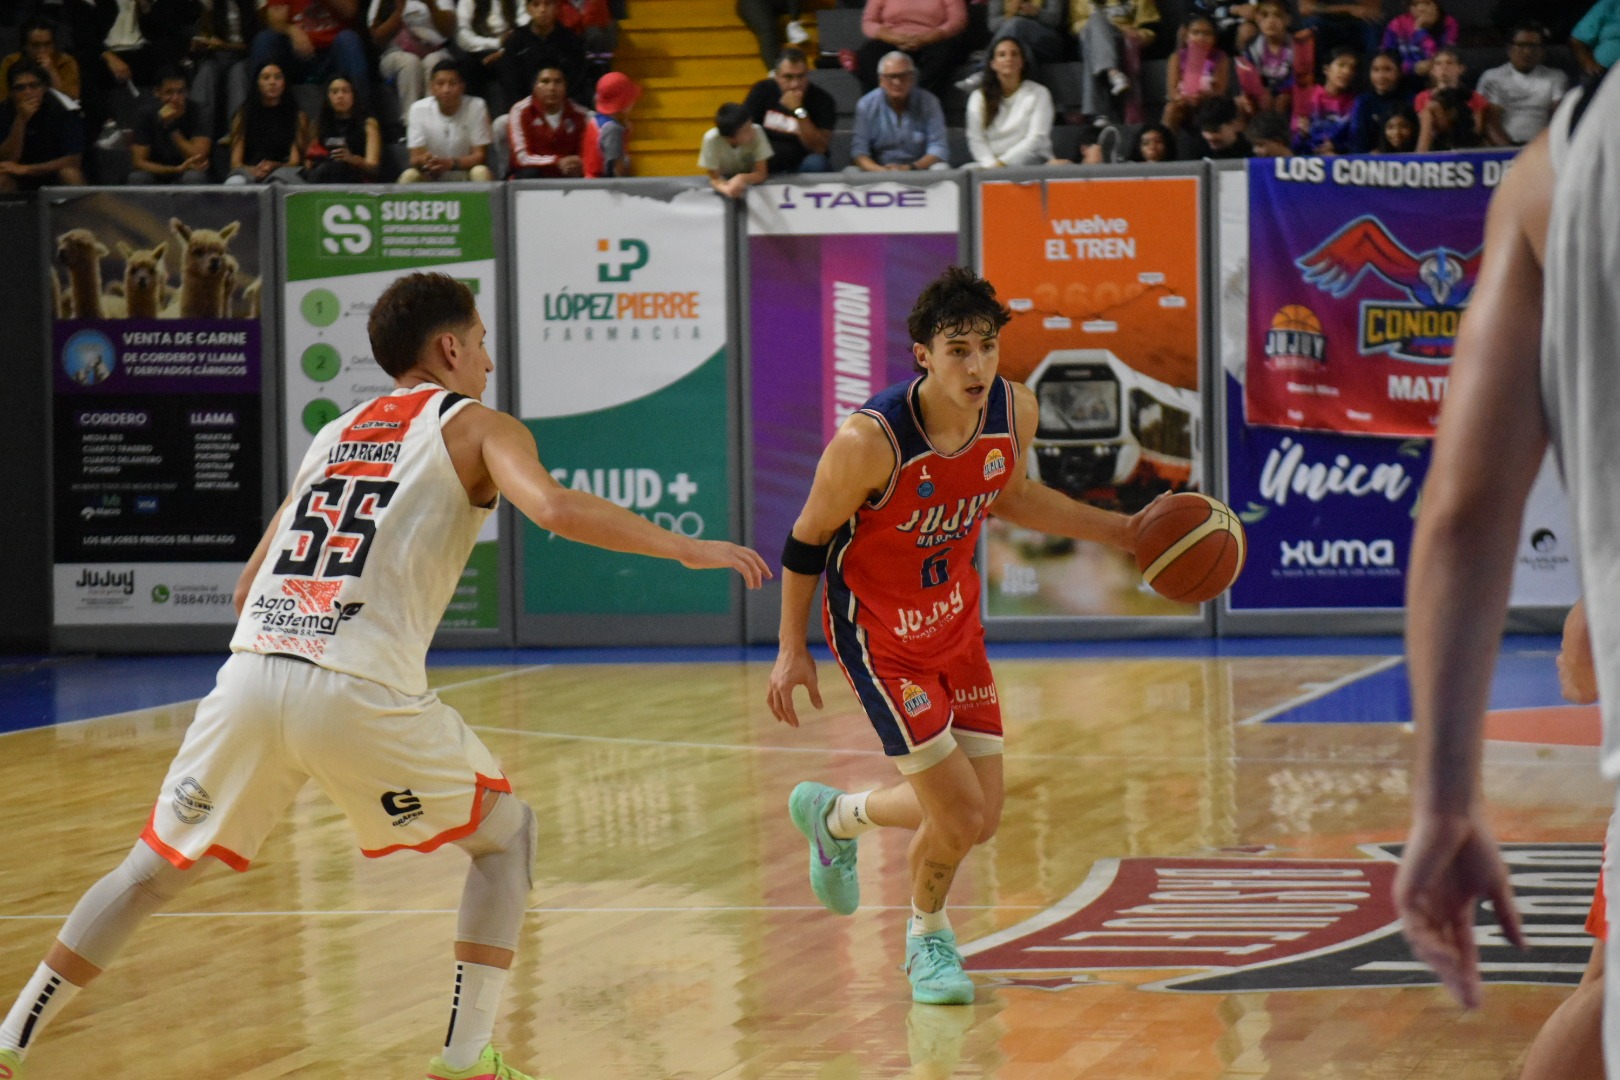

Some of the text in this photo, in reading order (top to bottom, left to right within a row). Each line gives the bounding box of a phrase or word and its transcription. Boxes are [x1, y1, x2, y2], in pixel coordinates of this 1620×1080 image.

[1274, 157, 1326, 184] LOS
[1332, 159, 1475, 188] CONDORES
[804, 190, 927, 208] TADE
[381, 200, 460, 221] SUSEPU
[1052, 215, 1129, 235] vuelve
[1045, 237, 1136, 260] EL TREN
[122, 331, 247, 345] VENTA DE CARNE
[543, 326, 701, 342] FARMACIA
[833, 281, 872, 377] MOTION
[123, 352, 246, 363] DE CORDERO Y LLAMA
[315, 356, 325, 369] 2
[80, 412, 147, 426] CORDERO
[190, 412, 235, 426] LLAMA
[272, 479, 401, 578] 55
[1280, 540, 1395, 567] xuma
[251, 594, 296, 613] Agro
[262, 611, 334, 630] sistema
